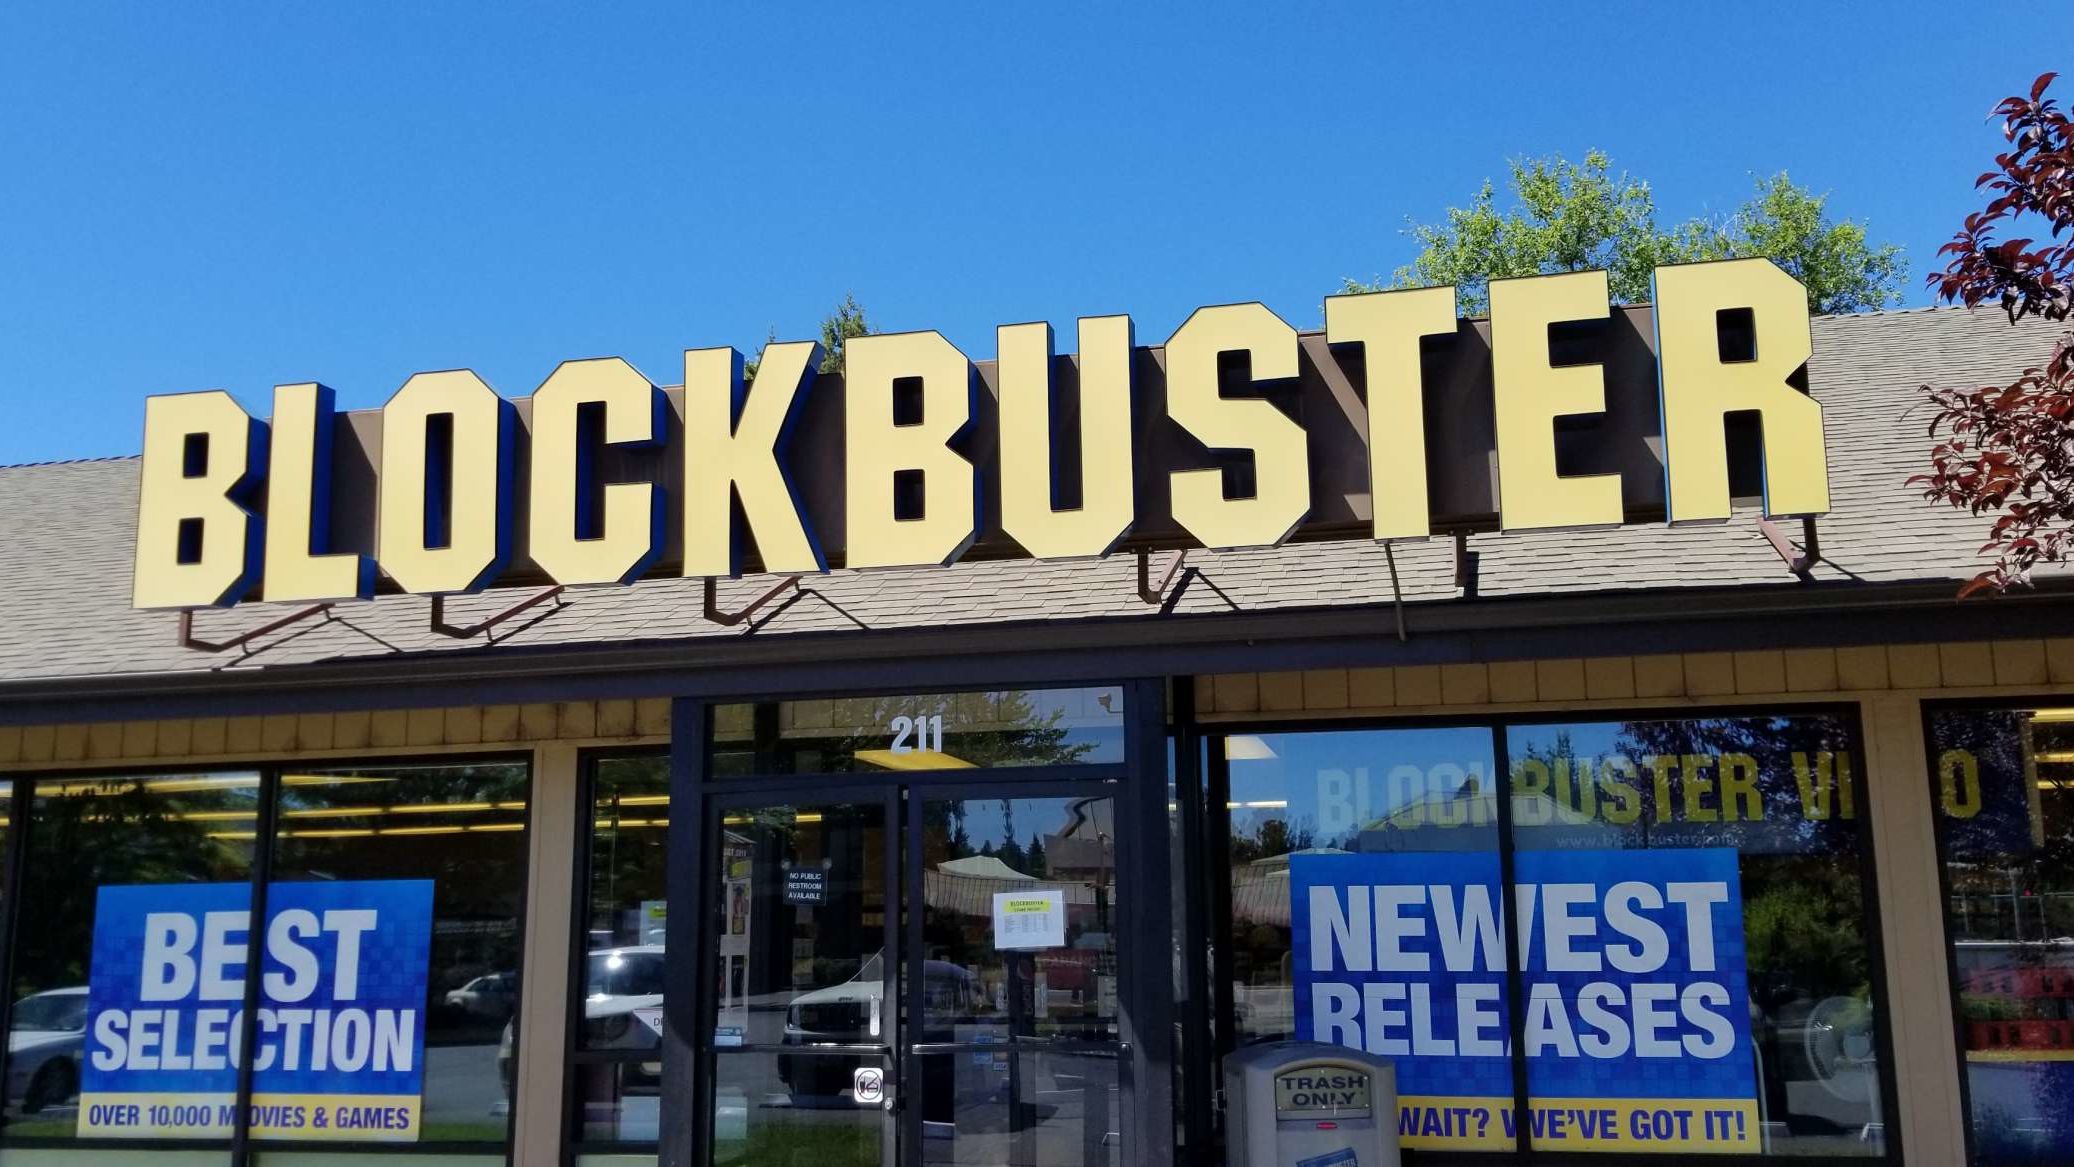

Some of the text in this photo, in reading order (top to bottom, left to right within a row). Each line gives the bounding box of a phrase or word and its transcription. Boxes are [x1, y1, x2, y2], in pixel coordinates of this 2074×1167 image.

[133, 257, 1831, 609] BLOCKBUSTER
[891, 715, 942, 753] 211
[788, 882, 822, 890] RESTROOM
[789, 872, 822, 880] NO PUBLIC
[788, 891, 821, 900] AVAILABLE
[1308, 881, 1728, 973] NEWEST
[140, 909, 377, 1003] BEST
[1311, 982, 1736, 1059] RELEASES
[91, 1008, 416, 1073] SELECTION
[1281, 1076, 1364, 1090] TRASH
[1292, 1091, 1356, 1106] ONLY
[89, 1105, 409, 1130] OVER 10,000 MOVIES & GAMES
[1629, 1110, 1693, 1141] GOT
[1703, 1110, 1746, 1141] IT!
